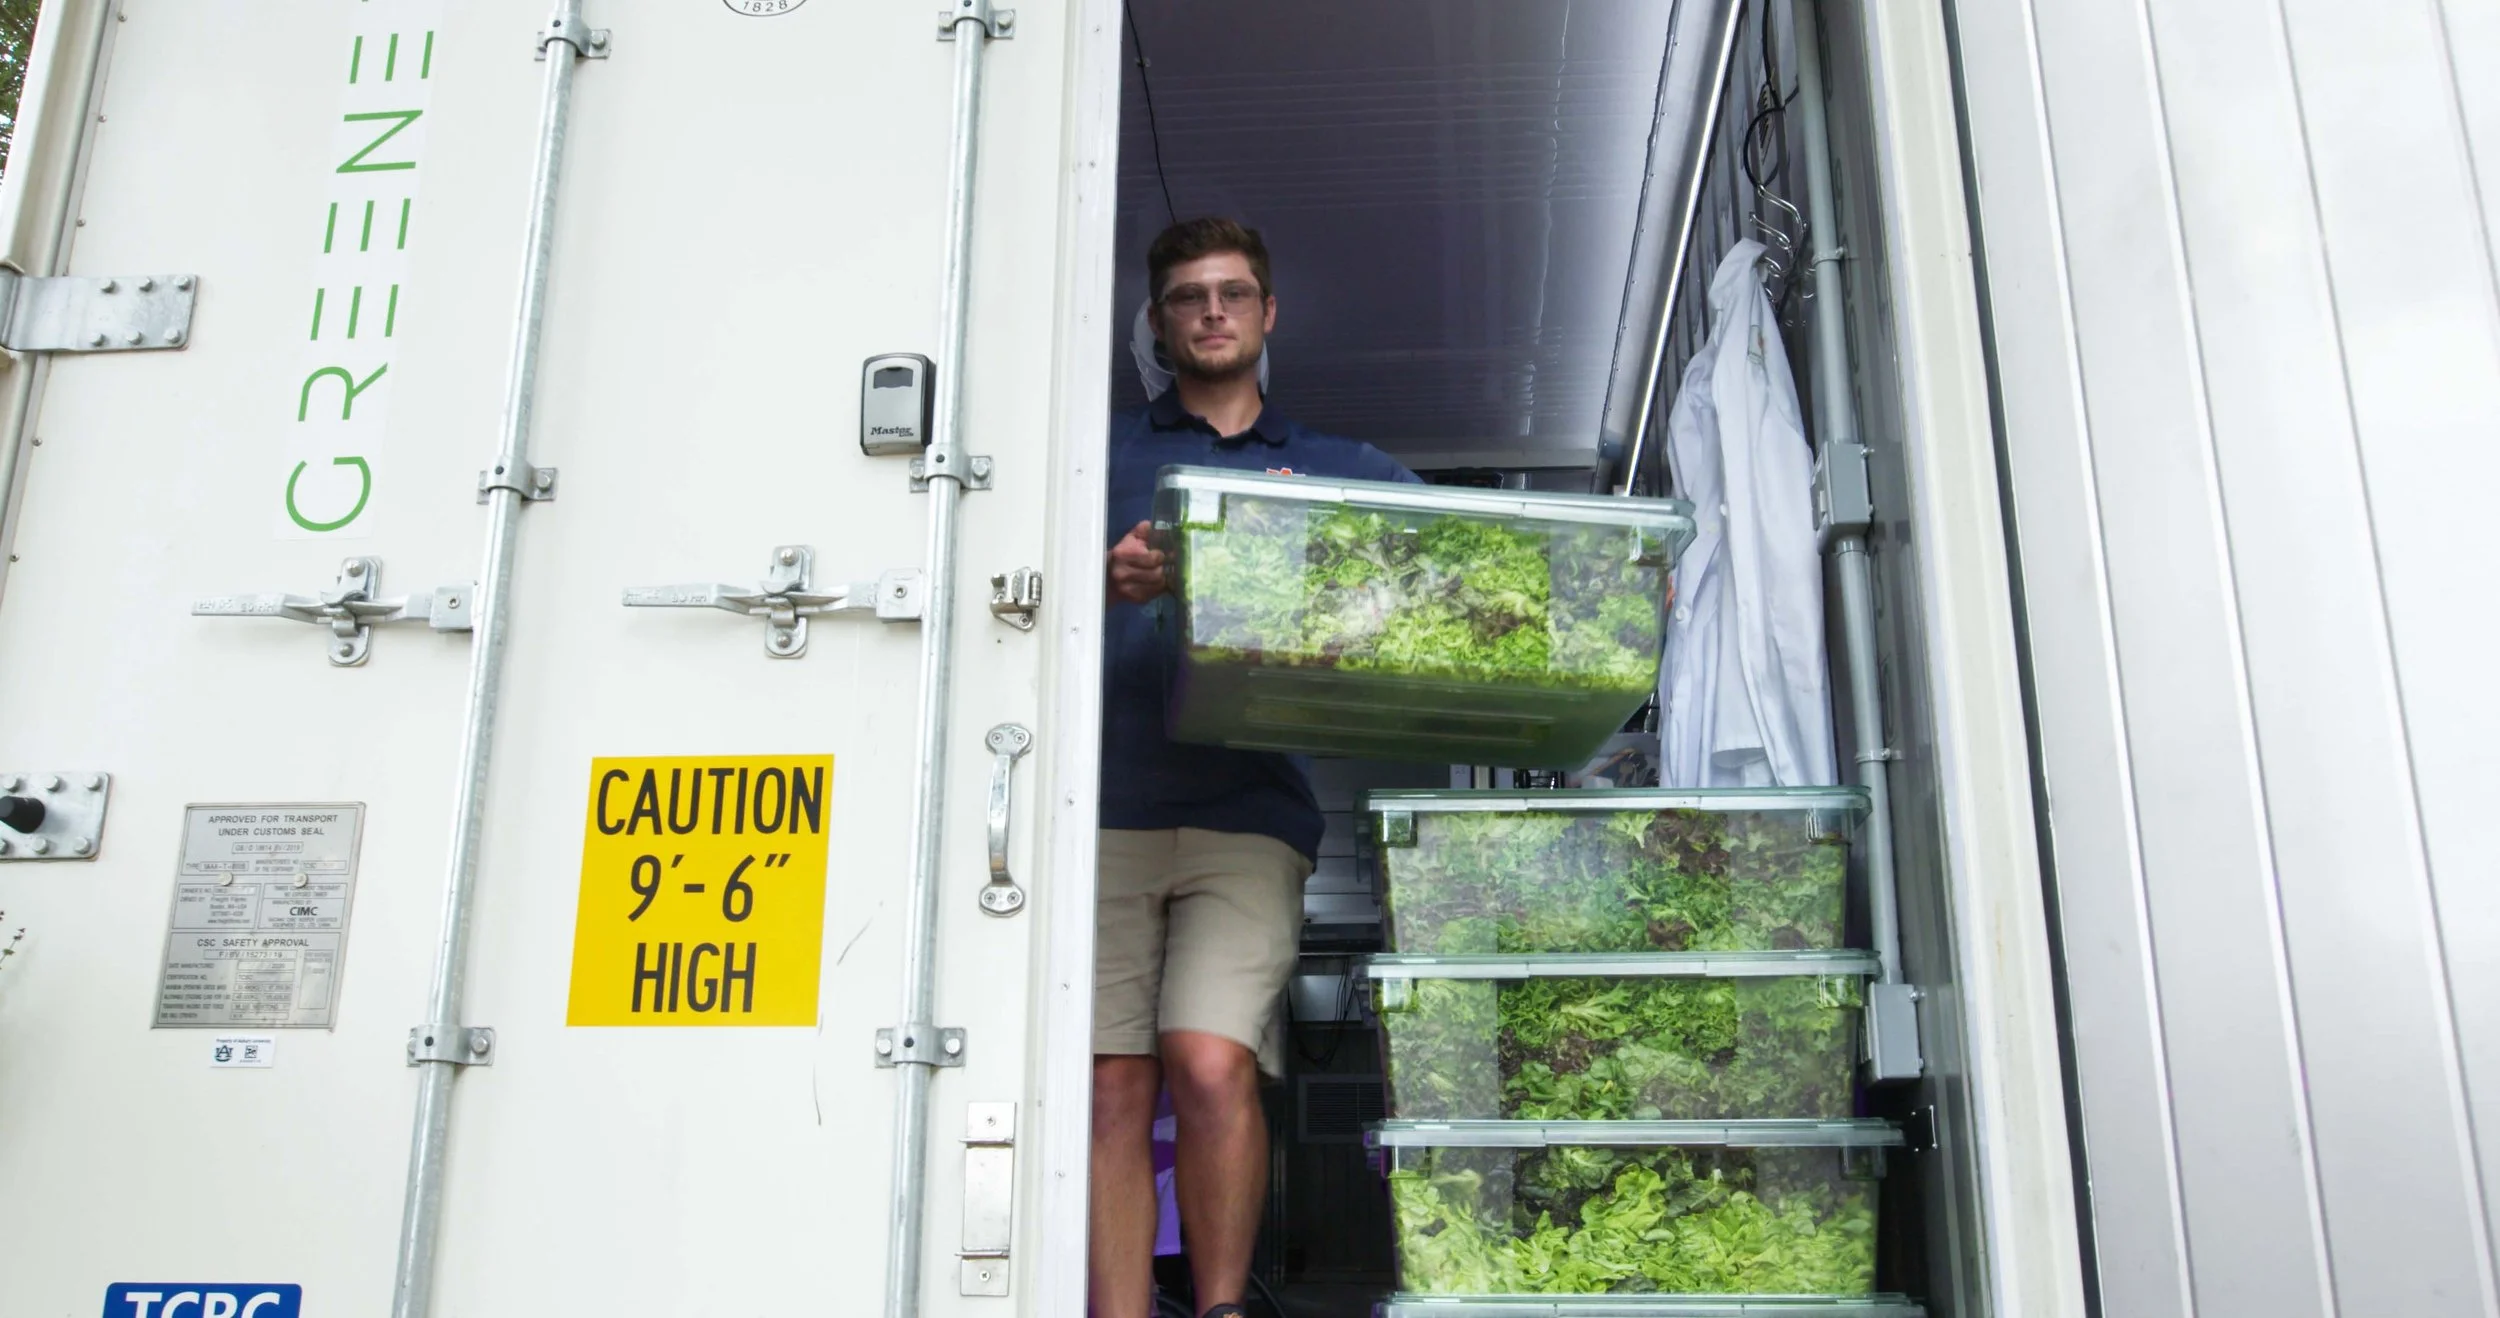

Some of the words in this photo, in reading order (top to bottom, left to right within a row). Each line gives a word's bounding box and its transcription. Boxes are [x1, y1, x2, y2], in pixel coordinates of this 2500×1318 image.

[742, 0, 789, 13] 1828
[285, 0, 435, 533] GREENE
[870, 426, 912, 435] Master
[596, 766, 825, 836] CAUTION
[208, 815, 257, 824] APPROVED
[261, 814, 279, 823] FOR
[284, 814, 338, 823] TRANSPORT
[218, 828, 249, 836] UNDER
[253, 827, 297, 836] CUSTOMS
[301, 827, 325, 836] SEAL
[289, 906, 319, 916] CIMC
[196, 939, 216, 947] CSC
[222, 939, 258, 947] SAFETY
[261, 938, 309, 947] APPROVAL
[631, 942, 757, 1013] HIGH
